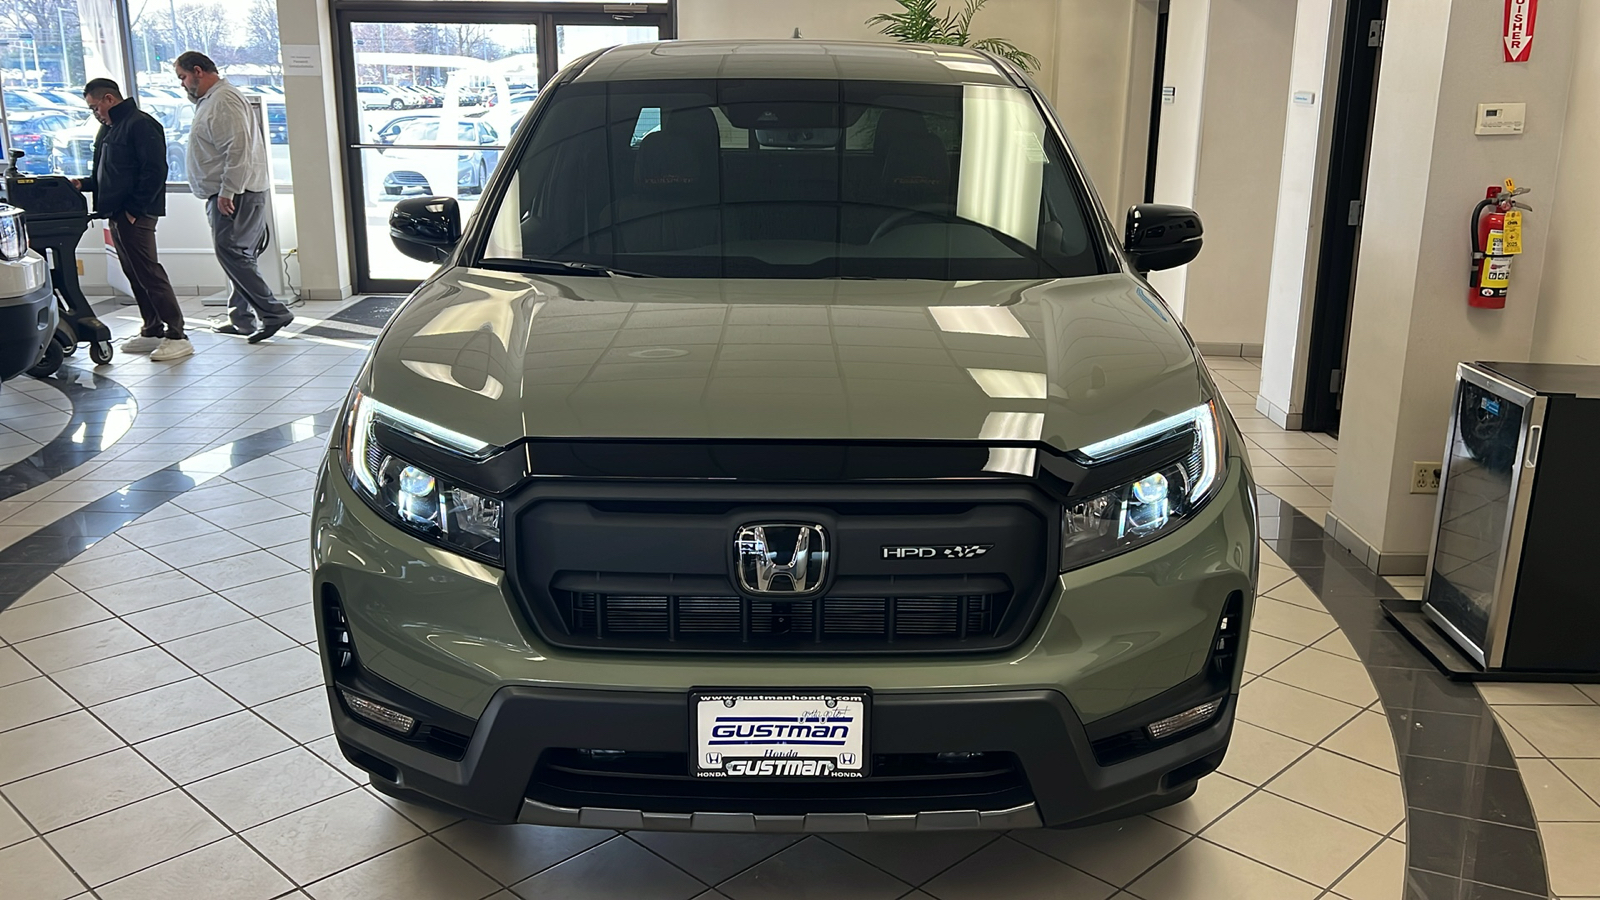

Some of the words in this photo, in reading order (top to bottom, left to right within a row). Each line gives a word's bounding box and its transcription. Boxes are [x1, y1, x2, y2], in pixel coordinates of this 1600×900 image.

[883, 547, 936, 558] HPD
[700, 694, 862, 702] www.gustmanhonda.com
[763, 749, 799, 757] Honda
